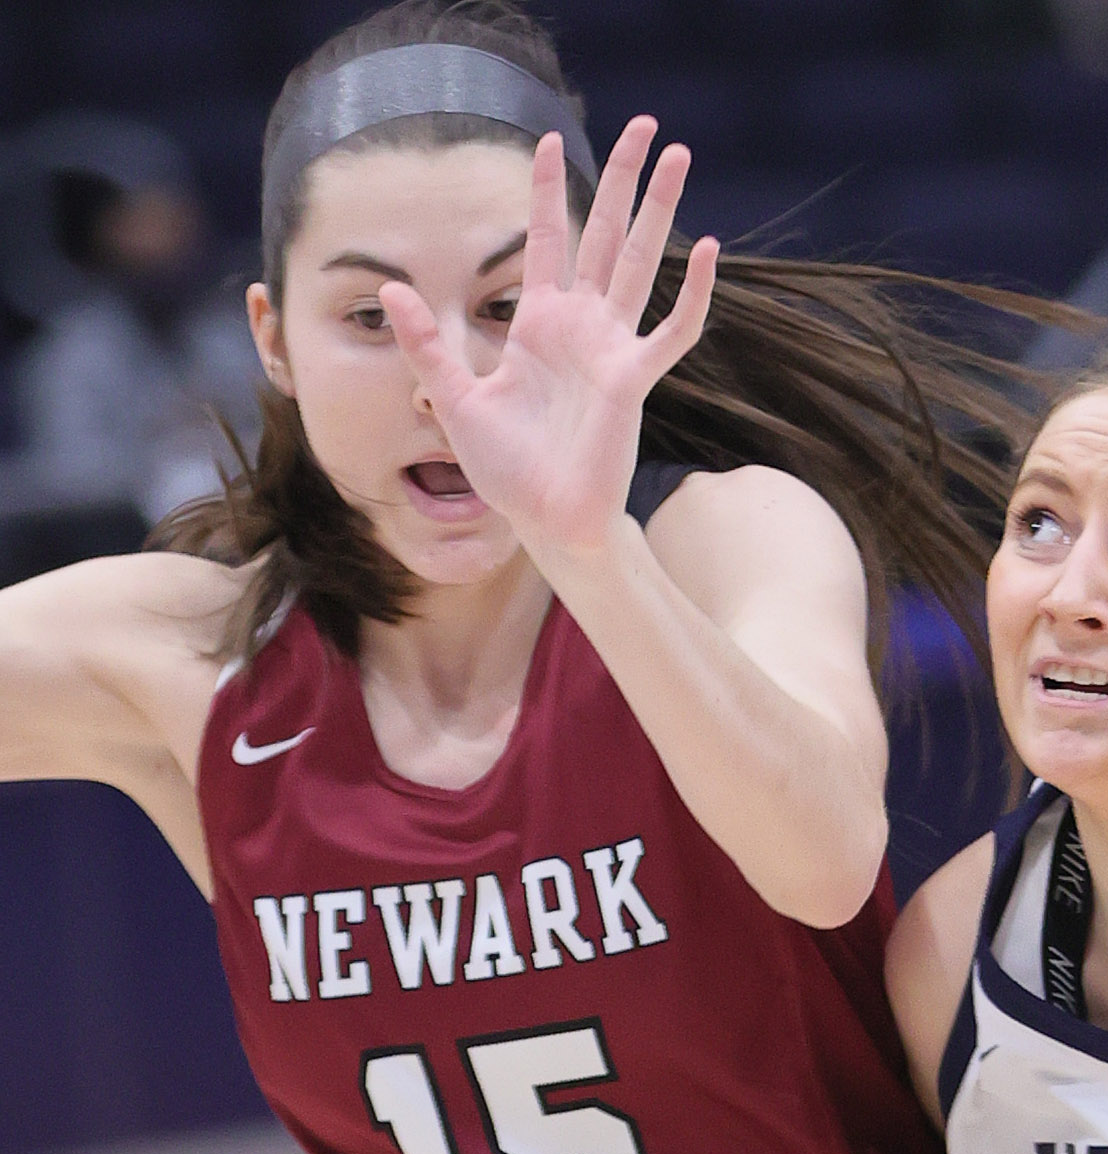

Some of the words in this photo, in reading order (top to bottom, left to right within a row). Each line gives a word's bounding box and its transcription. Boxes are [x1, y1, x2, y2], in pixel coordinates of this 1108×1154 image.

[1055, 831, 1086, 914] NIKE
[253, 835, 669, 1002] NEWARK
[1048, 945, 1076, 1015] NIK
